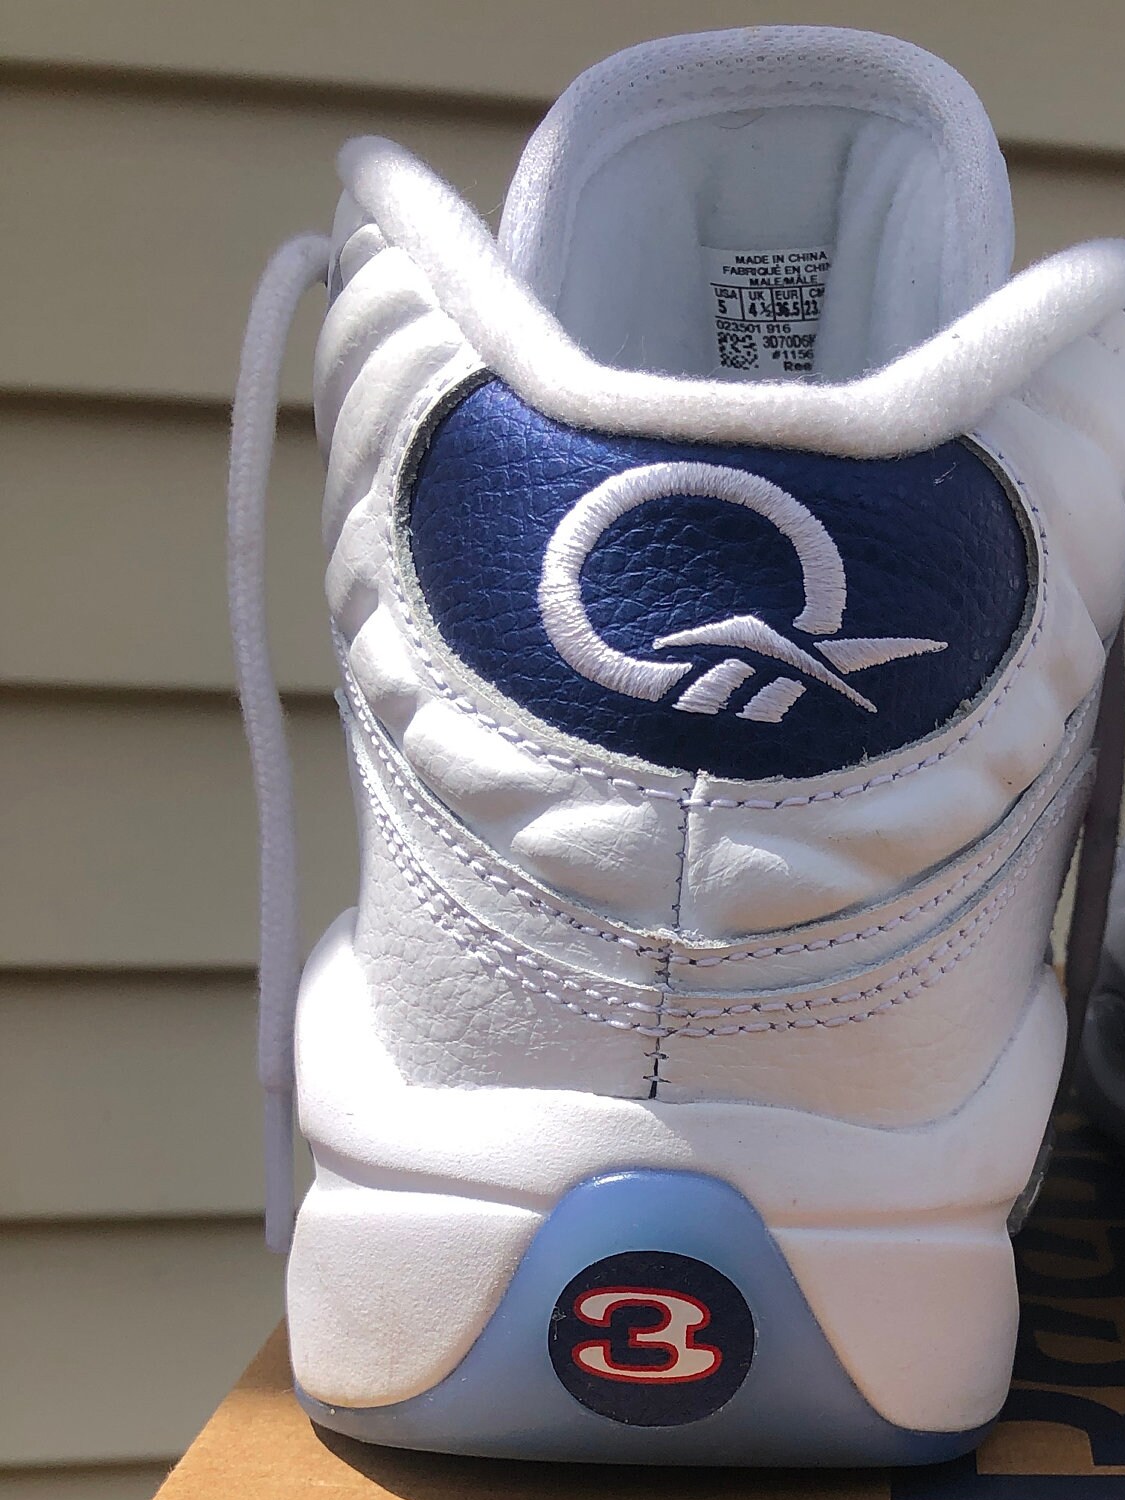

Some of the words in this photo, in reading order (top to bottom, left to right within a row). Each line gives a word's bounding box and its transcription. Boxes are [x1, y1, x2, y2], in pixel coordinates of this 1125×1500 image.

[735, 255, 769, 265] MADE
[772, 254, 785, 264] IN
[788, 251, 828, 263] CHINA
[722, 264, 782, 276] FABRIQUÉ
[784, 265, 800, 275] EN
[714, 288, 738, 300] USA
[748, 291, 765, 301] UK
[774, 289, 799, 301] EUR
[718, 300, 728, 314] 5
[775, 301, 801, 317] 36.5
[716, 320, 761, 334] 023501
[766, 323, 791, 334] 916
[572, 1286, 722, 1384] 3
